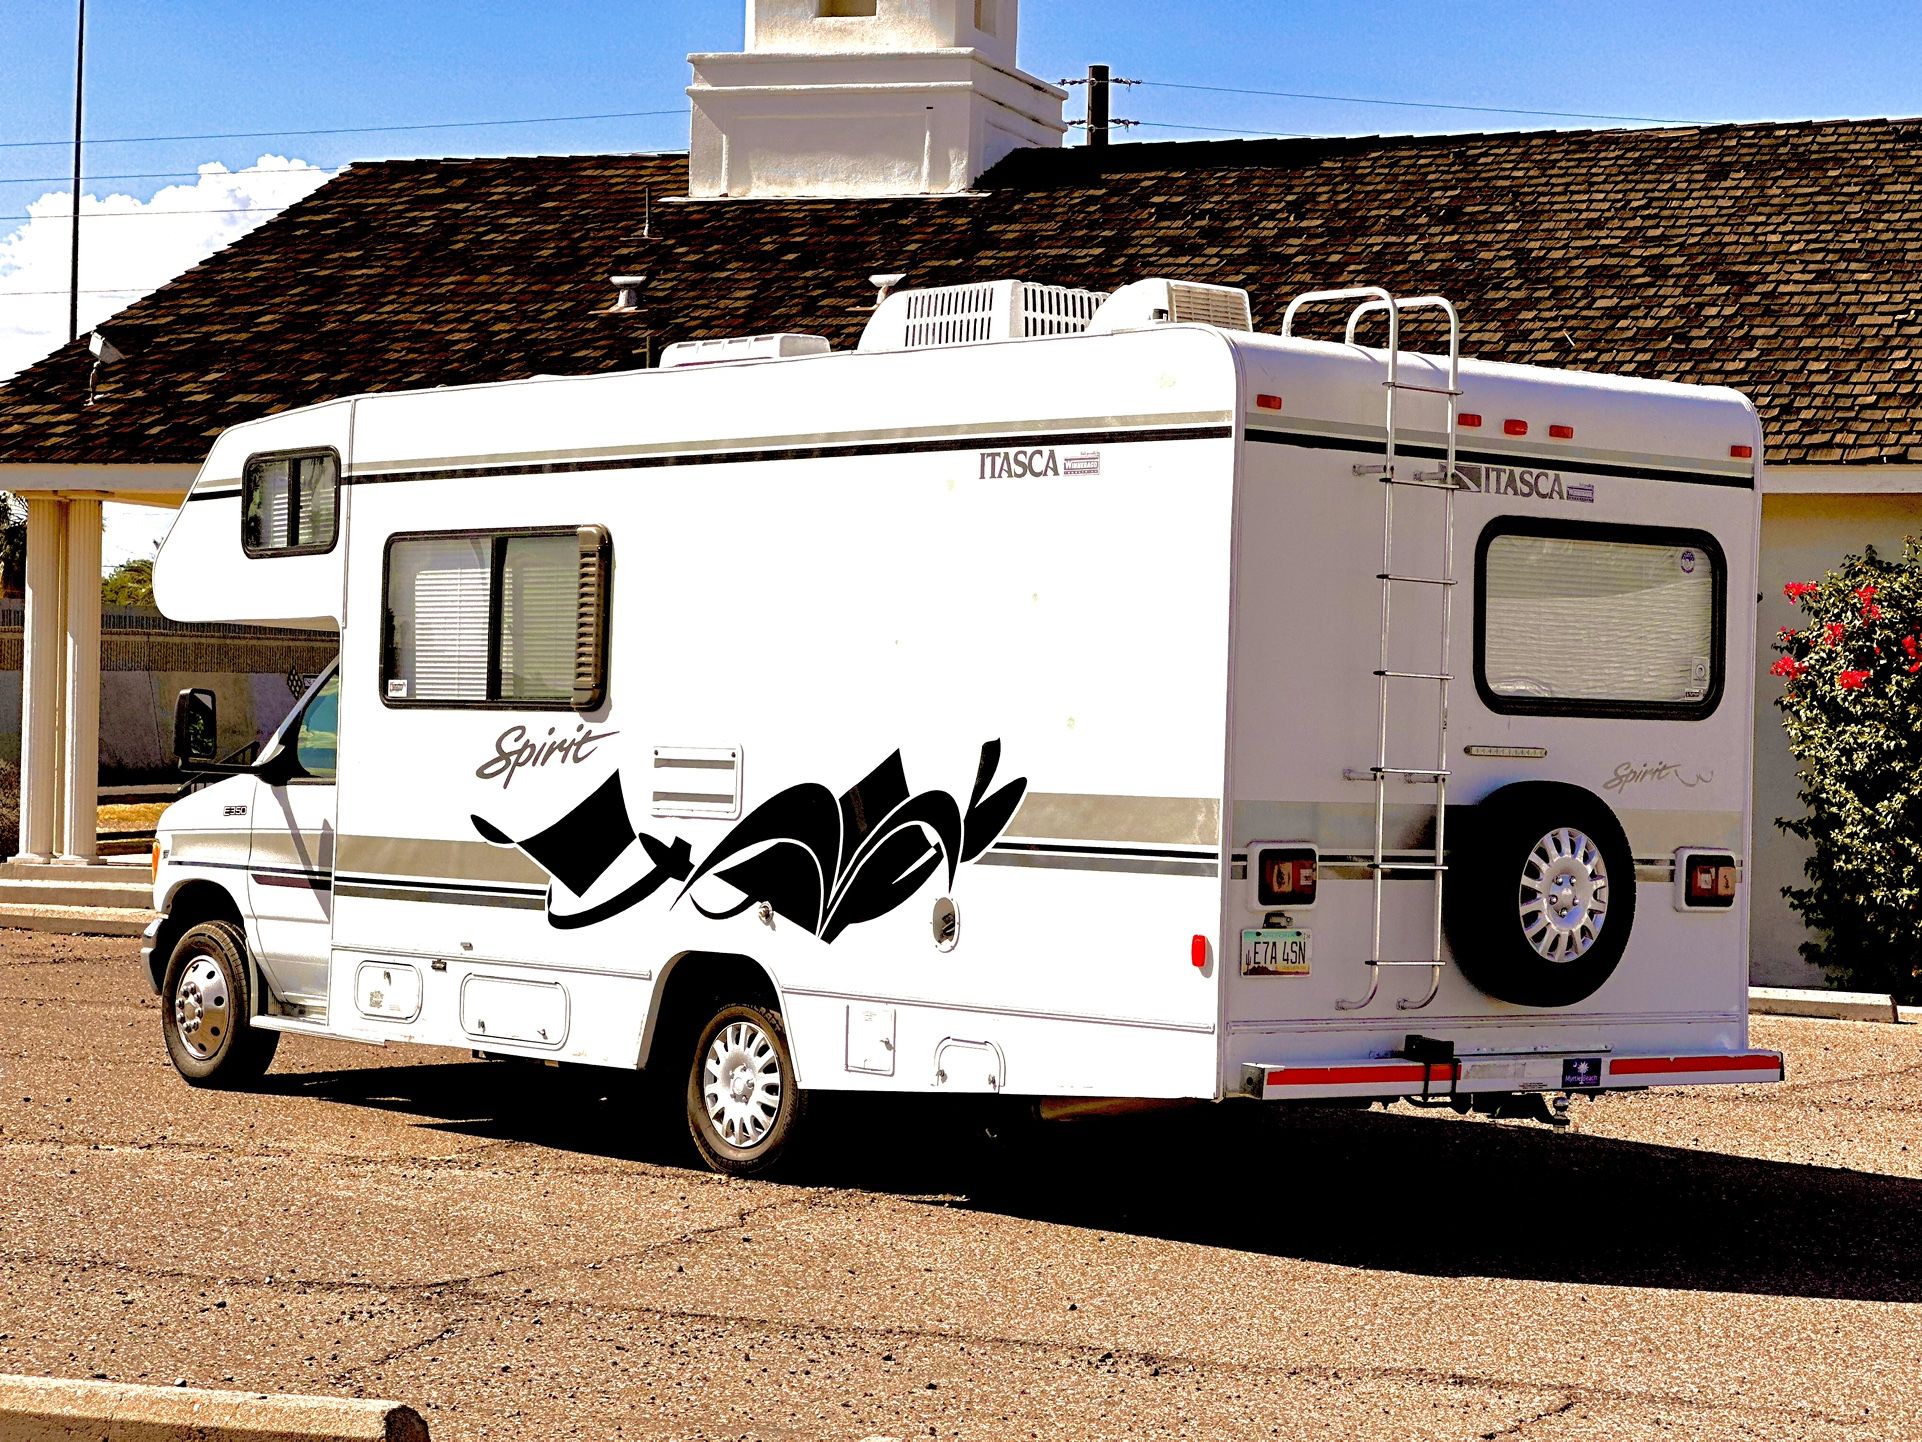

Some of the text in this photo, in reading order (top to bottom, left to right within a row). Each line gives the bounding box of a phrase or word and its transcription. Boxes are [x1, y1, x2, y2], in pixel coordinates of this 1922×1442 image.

[979, 449, 1060, 480] ITASCA
[1484, 466, 1565, 500] ITASCA
[475, 723, 620, 790] Spirit
[1602, 761, 1682, 794] Spirit
[1253, 941, 1306, 965] E7A 4SN
